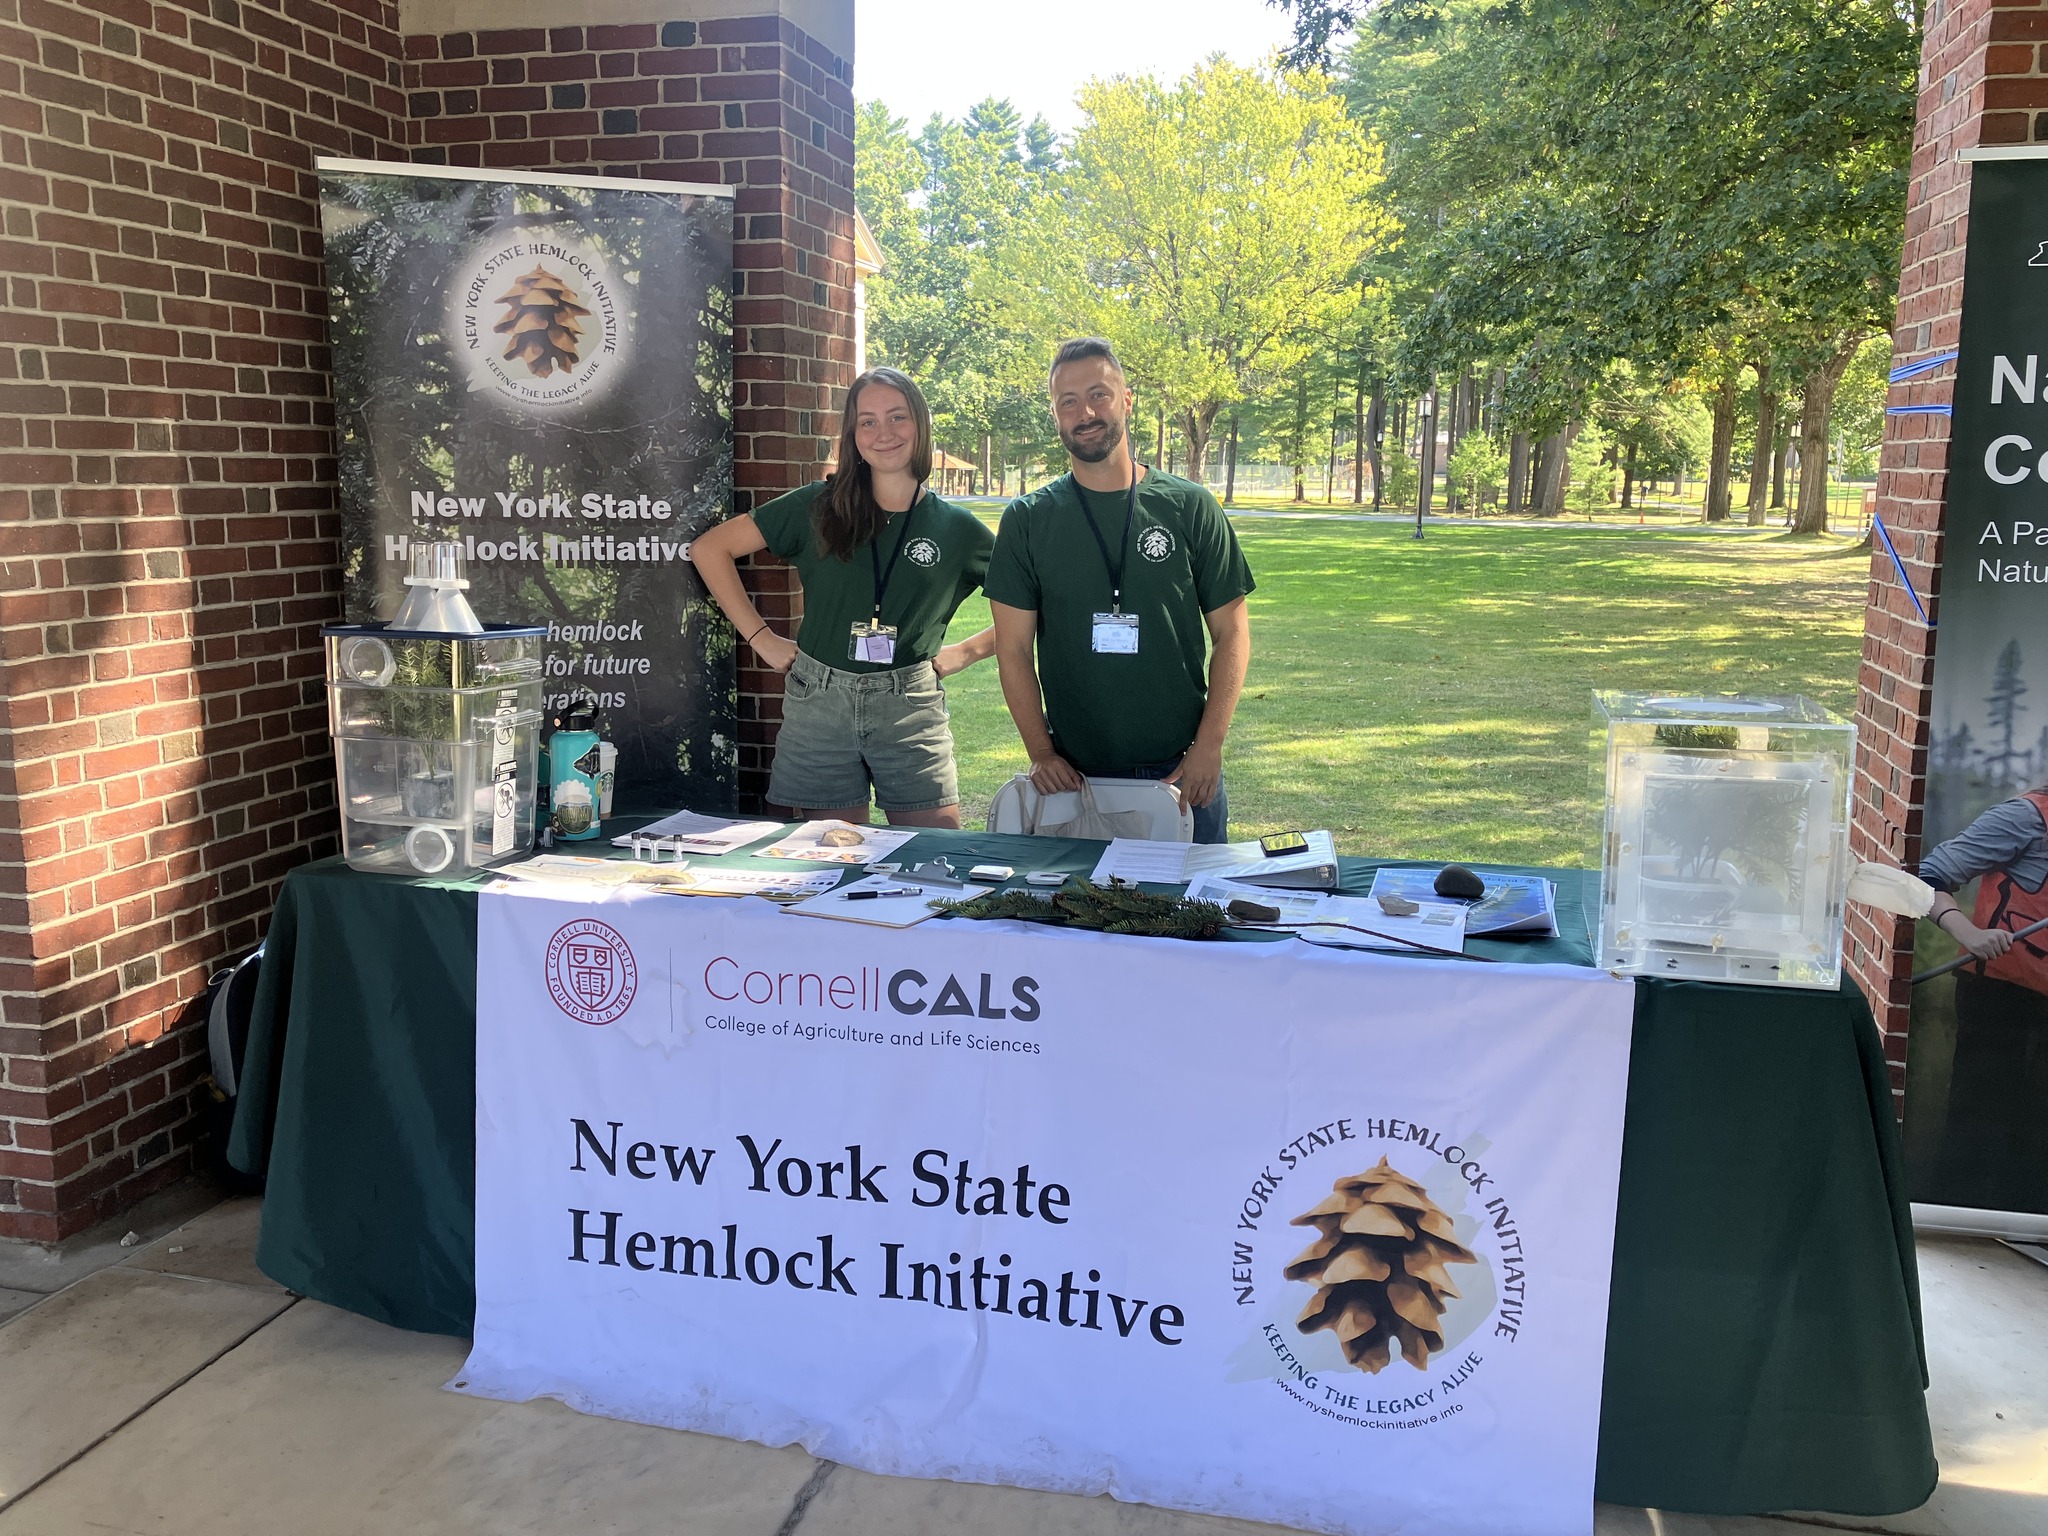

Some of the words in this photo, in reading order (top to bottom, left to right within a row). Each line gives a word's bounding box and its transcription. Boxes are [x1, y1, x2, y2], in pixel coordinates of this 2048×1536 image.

[484, 244, 524, 275] STATE
[528, 243, 596, 281] HEMLOCK
[466, 273, 489, 309] YORK
[465, 315, 480, 350] NEW
[592, 280, 617, 355] INITIATIVE
[485, 356, 517, 390] KEEPING
[521, 386, 540, 398] THE
[543, 382, 578, 399] LEGACY
[580, 360, 599, 386] ALIVE
[410, 490, 486, 518] New
[494, 491, 573, 519] York
[580, 492, 672, 520] State
[384, 534, 540, 561] Hlock
[550, 535, 692, 562] Initiative
[1978, 521, 2003, 545] A
[546, 619, 644, 642] hemlock
[545, 654, 578, 676] for
[583, 653, 651, 675] future
[549, 924, 580, 969] CORNELL
[583, 923, 634, 978] UNIVERSITY
[550, 977, 594, 1021] FOUNDED
[597, 1010, 616, 1022] A.D.
[615, 985, 633, 1011] 1865
[705, 1015, 766, 1036] College
[772, 1021, 789, 1036] of
[793, 1022, 884, 1044] Agriculture
[890, 1032, 923, 1046] and
[931, 1030, 962, 1047] Life
[966, 1034, 1041, 1055] Sciences
[1279, 1118, 1356, 1170] STATE
[1367, 1118, 1494, 1194] HEMLOCK
[569, 1117, 716, 1186] New
[736, 1133, 889, 1203] York
[911, 1149, 1071, 1224] State
[1237, 1165, 1284, 1231] YORK
[567, 1207, 858, 1297] Hemlock
[878, 1242, 1185, 1346] Initiative
[1232, 1241, 1256, 1306] NEW
[1485, 1197, 1526, 1344] INITIATIVE
[1263, 1322, 1319, 1391] KEEPING
[1324, 1385, 1360, 1411] THE
[1365, 1388, 1436, 1415] LEGACY
[1442, 1350, 1484, 1395] ALIVE
[1276, 1377, 1464, 1430] www.nyshemlockinitiative.info
